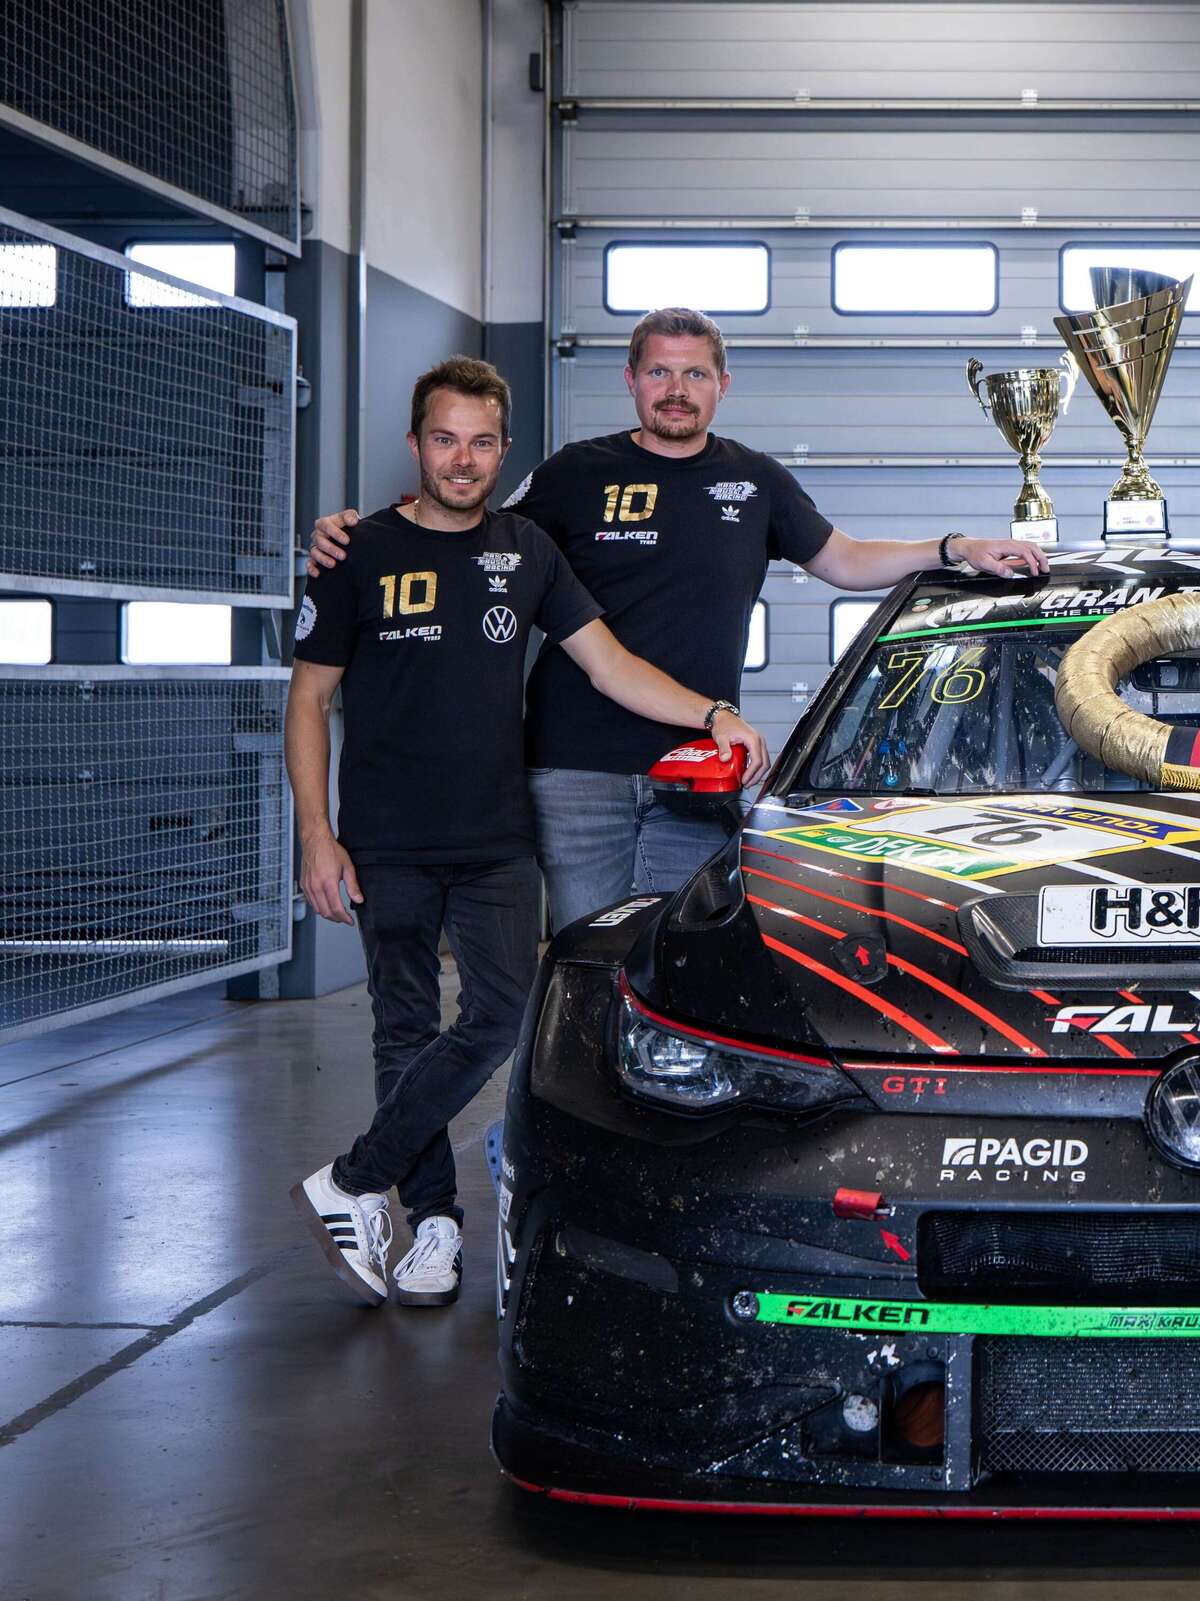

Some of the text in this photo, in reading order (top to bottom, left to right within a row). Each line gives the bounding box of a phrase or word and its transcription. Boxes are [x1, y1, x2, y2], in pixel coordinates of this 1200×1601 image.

[603, 483, 659, 522] 10
[721, 515, 740, 523] adidas
[595, 531, 658, 541] FALKEN
[379, 571, 437, 619] 10
[1040, 587, 1165, 609] GRAN
[1041, 609, 1081, 618] THE
[379, 625, 442, 640] FALKEN
[878, 646, 987, 710] 76
[925, 811, 1068, 846] 76
[839, 836, 974, 873] DEKRA
[882, 1075, 948, 1096] GTI
[979, 1138, 1089, 1166] PAGID
[940, 1169, 1086, 1182] RACING
[786, 1301, 930, 1325] FALKEN
[1109, 1314, 1150, 1328] MAX
